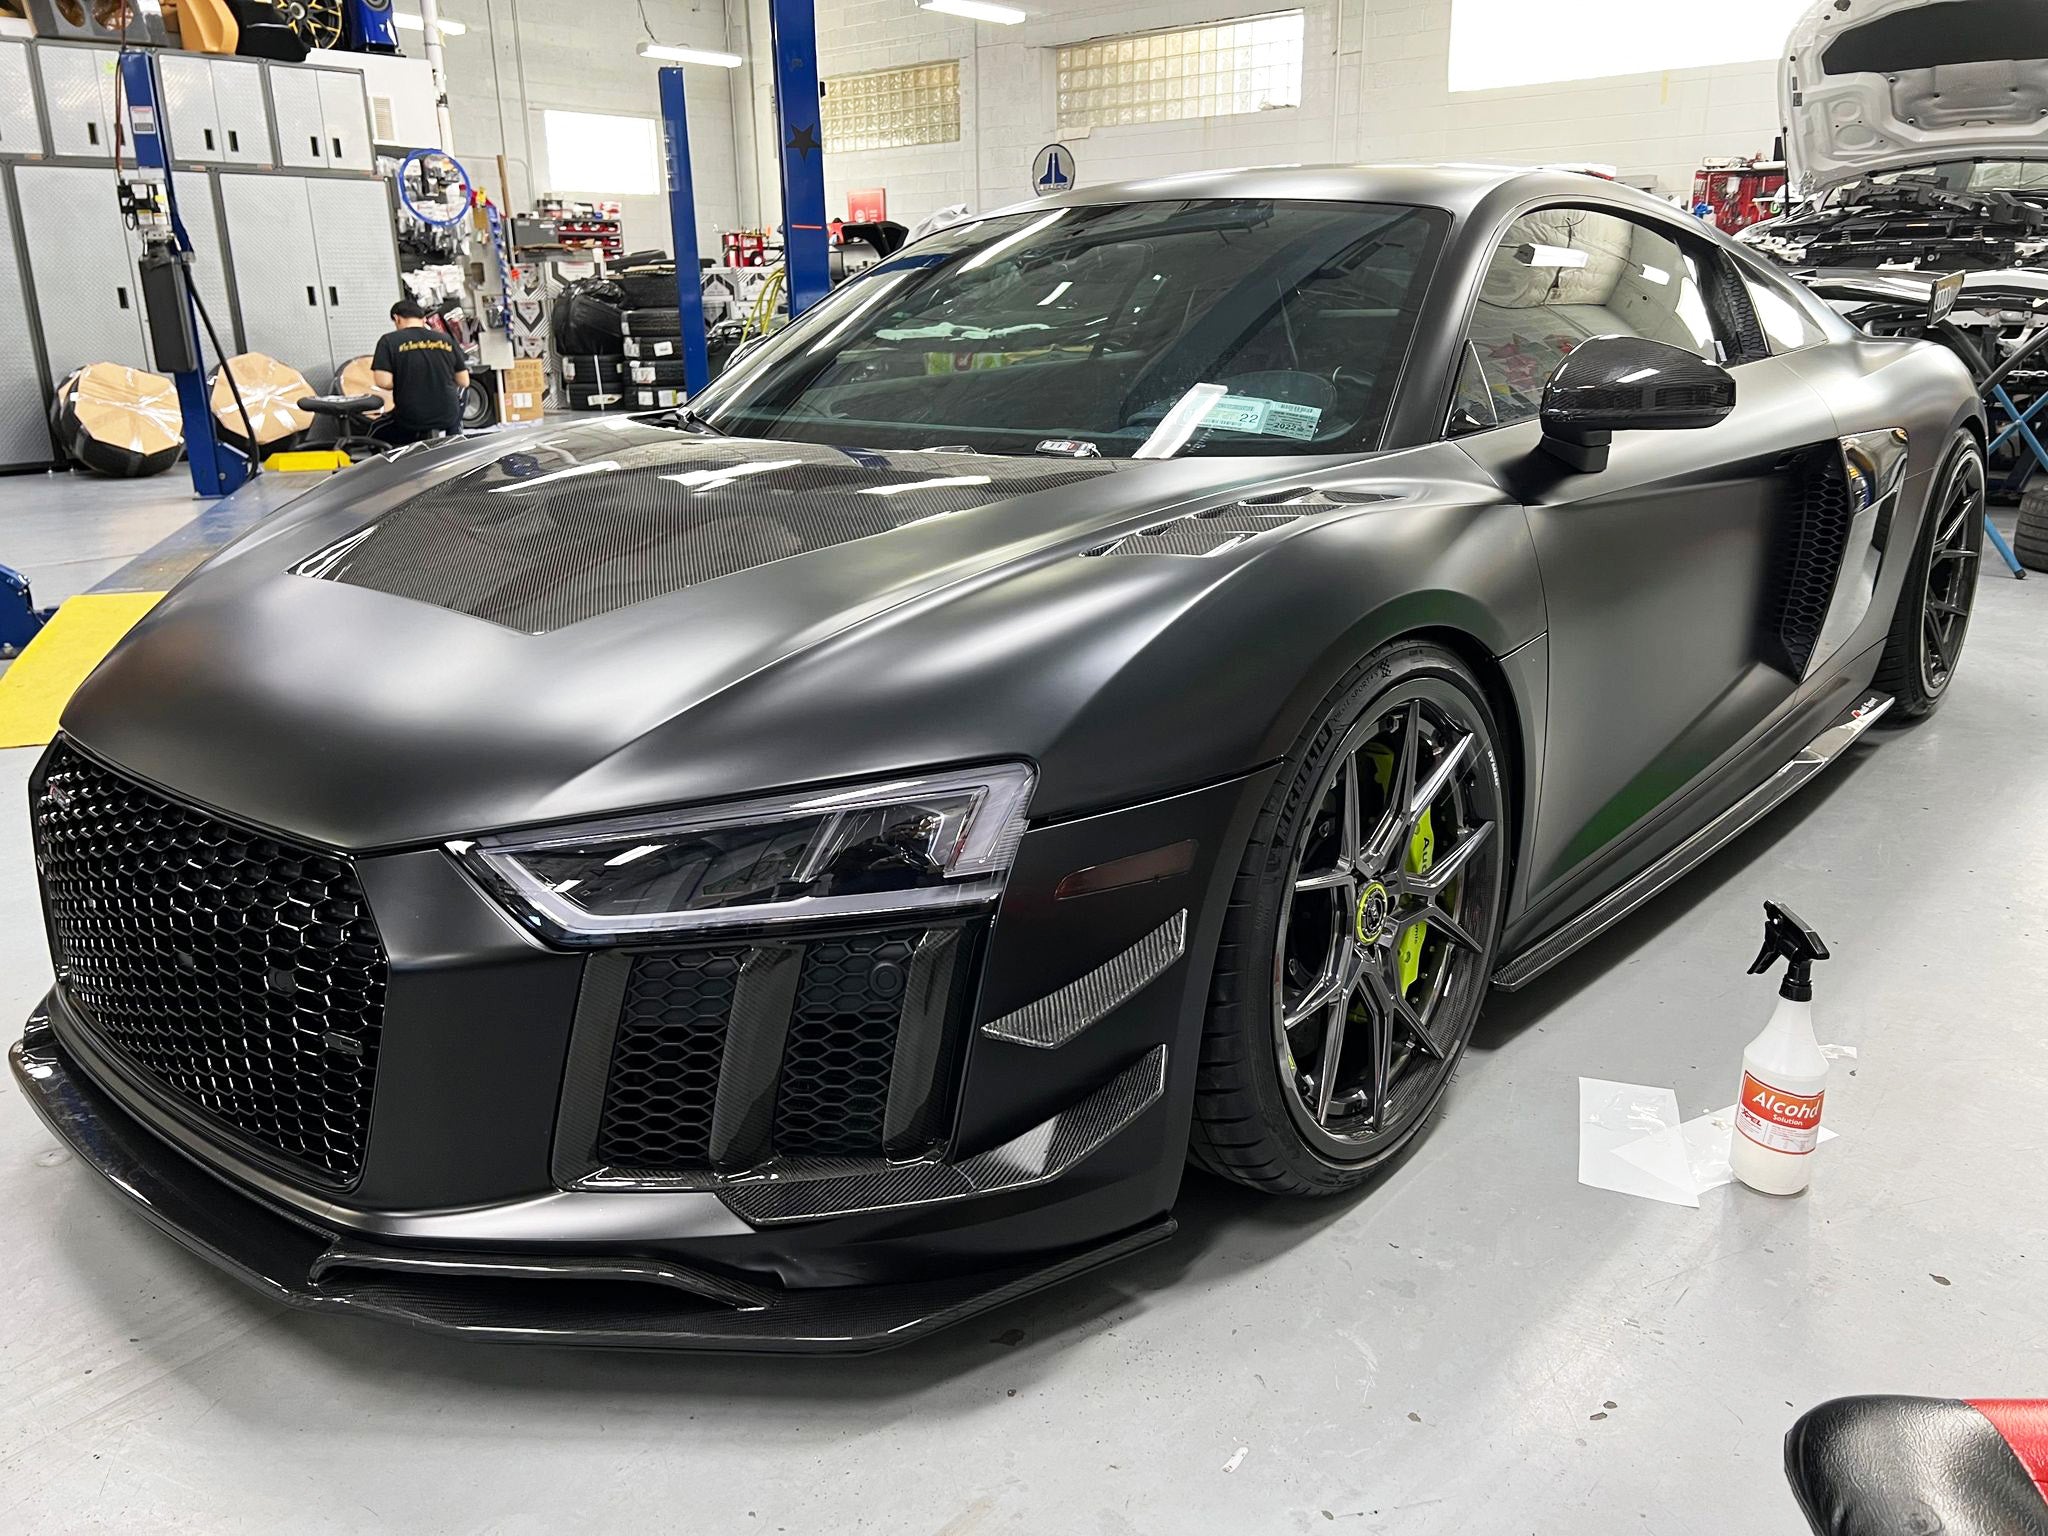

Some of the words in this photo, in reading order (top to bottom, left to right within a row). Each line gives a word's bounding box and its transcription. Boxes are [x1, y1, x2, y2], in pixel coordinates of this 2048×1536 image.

[1240, 413, 1259, 424] 22
[1274, 422, 1296, 432] 2022
[1277, 726, 1332, 842] MICHELIN
[1773, 1113, 1803, 1126] Solution
